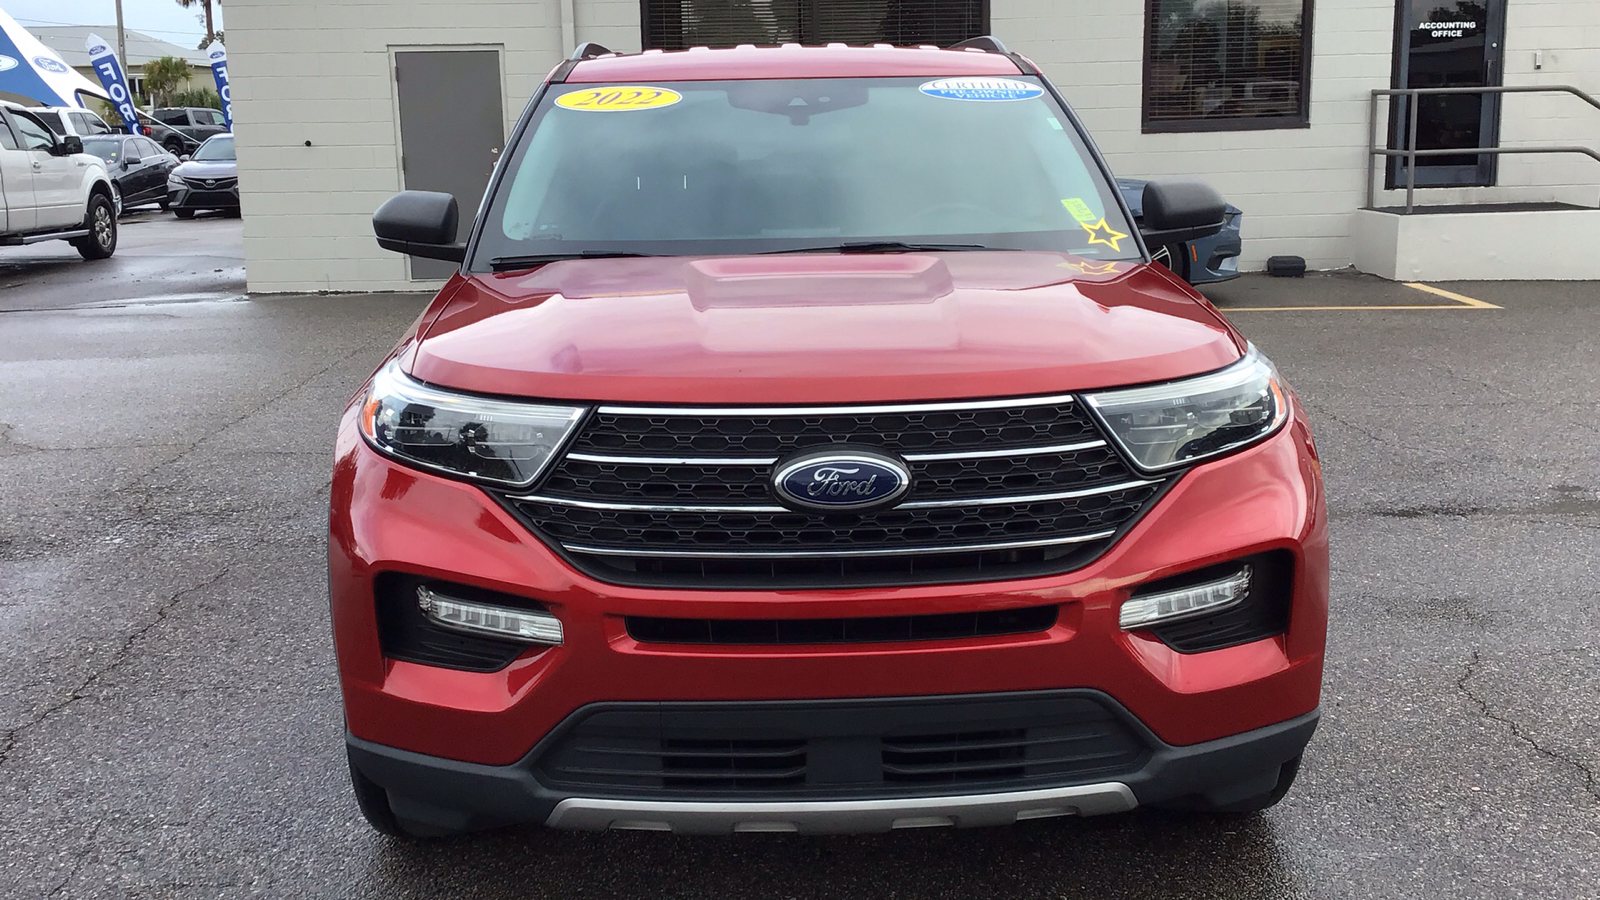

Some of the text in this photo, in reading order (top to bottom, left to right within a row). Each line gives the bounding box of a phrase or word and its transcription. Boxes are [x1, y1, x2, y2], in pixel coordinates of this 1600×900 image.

[1419, 21, 1476, 29] ACCOUNTING
[1431, 30, 1463, 38] OFFICE
[574, 91, 662, 106] 2022
[806, 466, 878, 497] Ford
